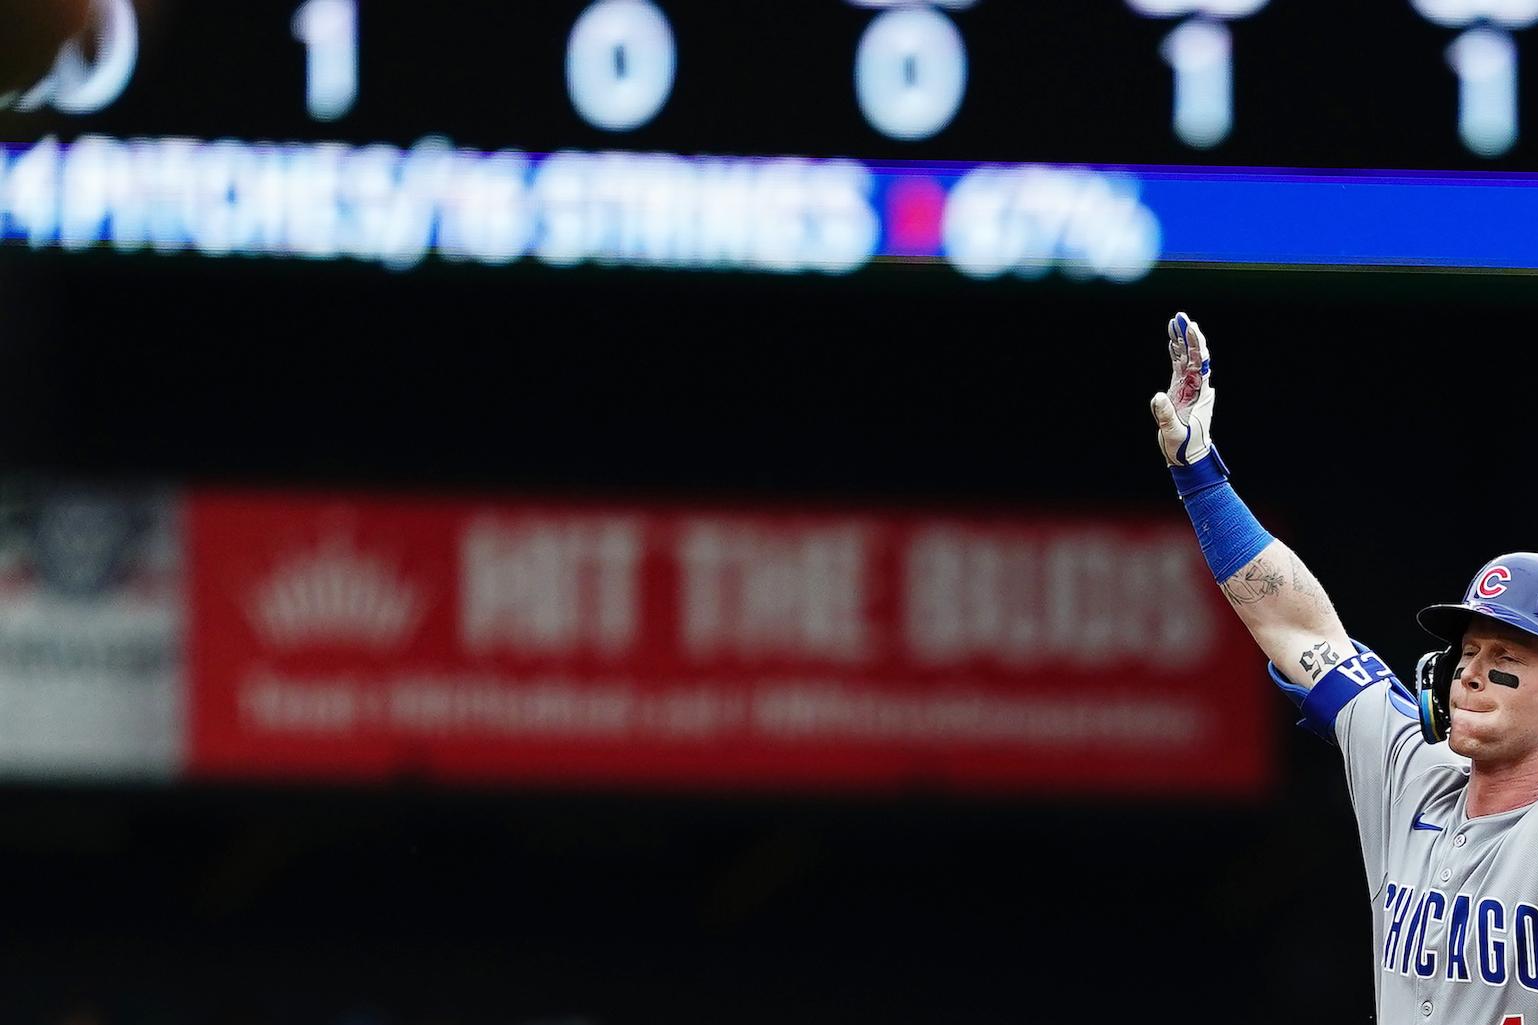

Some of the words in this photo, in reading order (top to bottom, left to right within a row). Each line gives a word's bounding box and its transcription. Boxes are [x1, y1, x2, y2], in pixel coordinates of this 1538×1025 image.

[292, 0, 358, 120] 1
[566, 0, 676, 131] 0
[855, 5, 967, 140] 0
[1163, 18, 1233, 148] 1
[1448, 26, 1520, 156] 1
[1477, 565, 1511, 598] C
